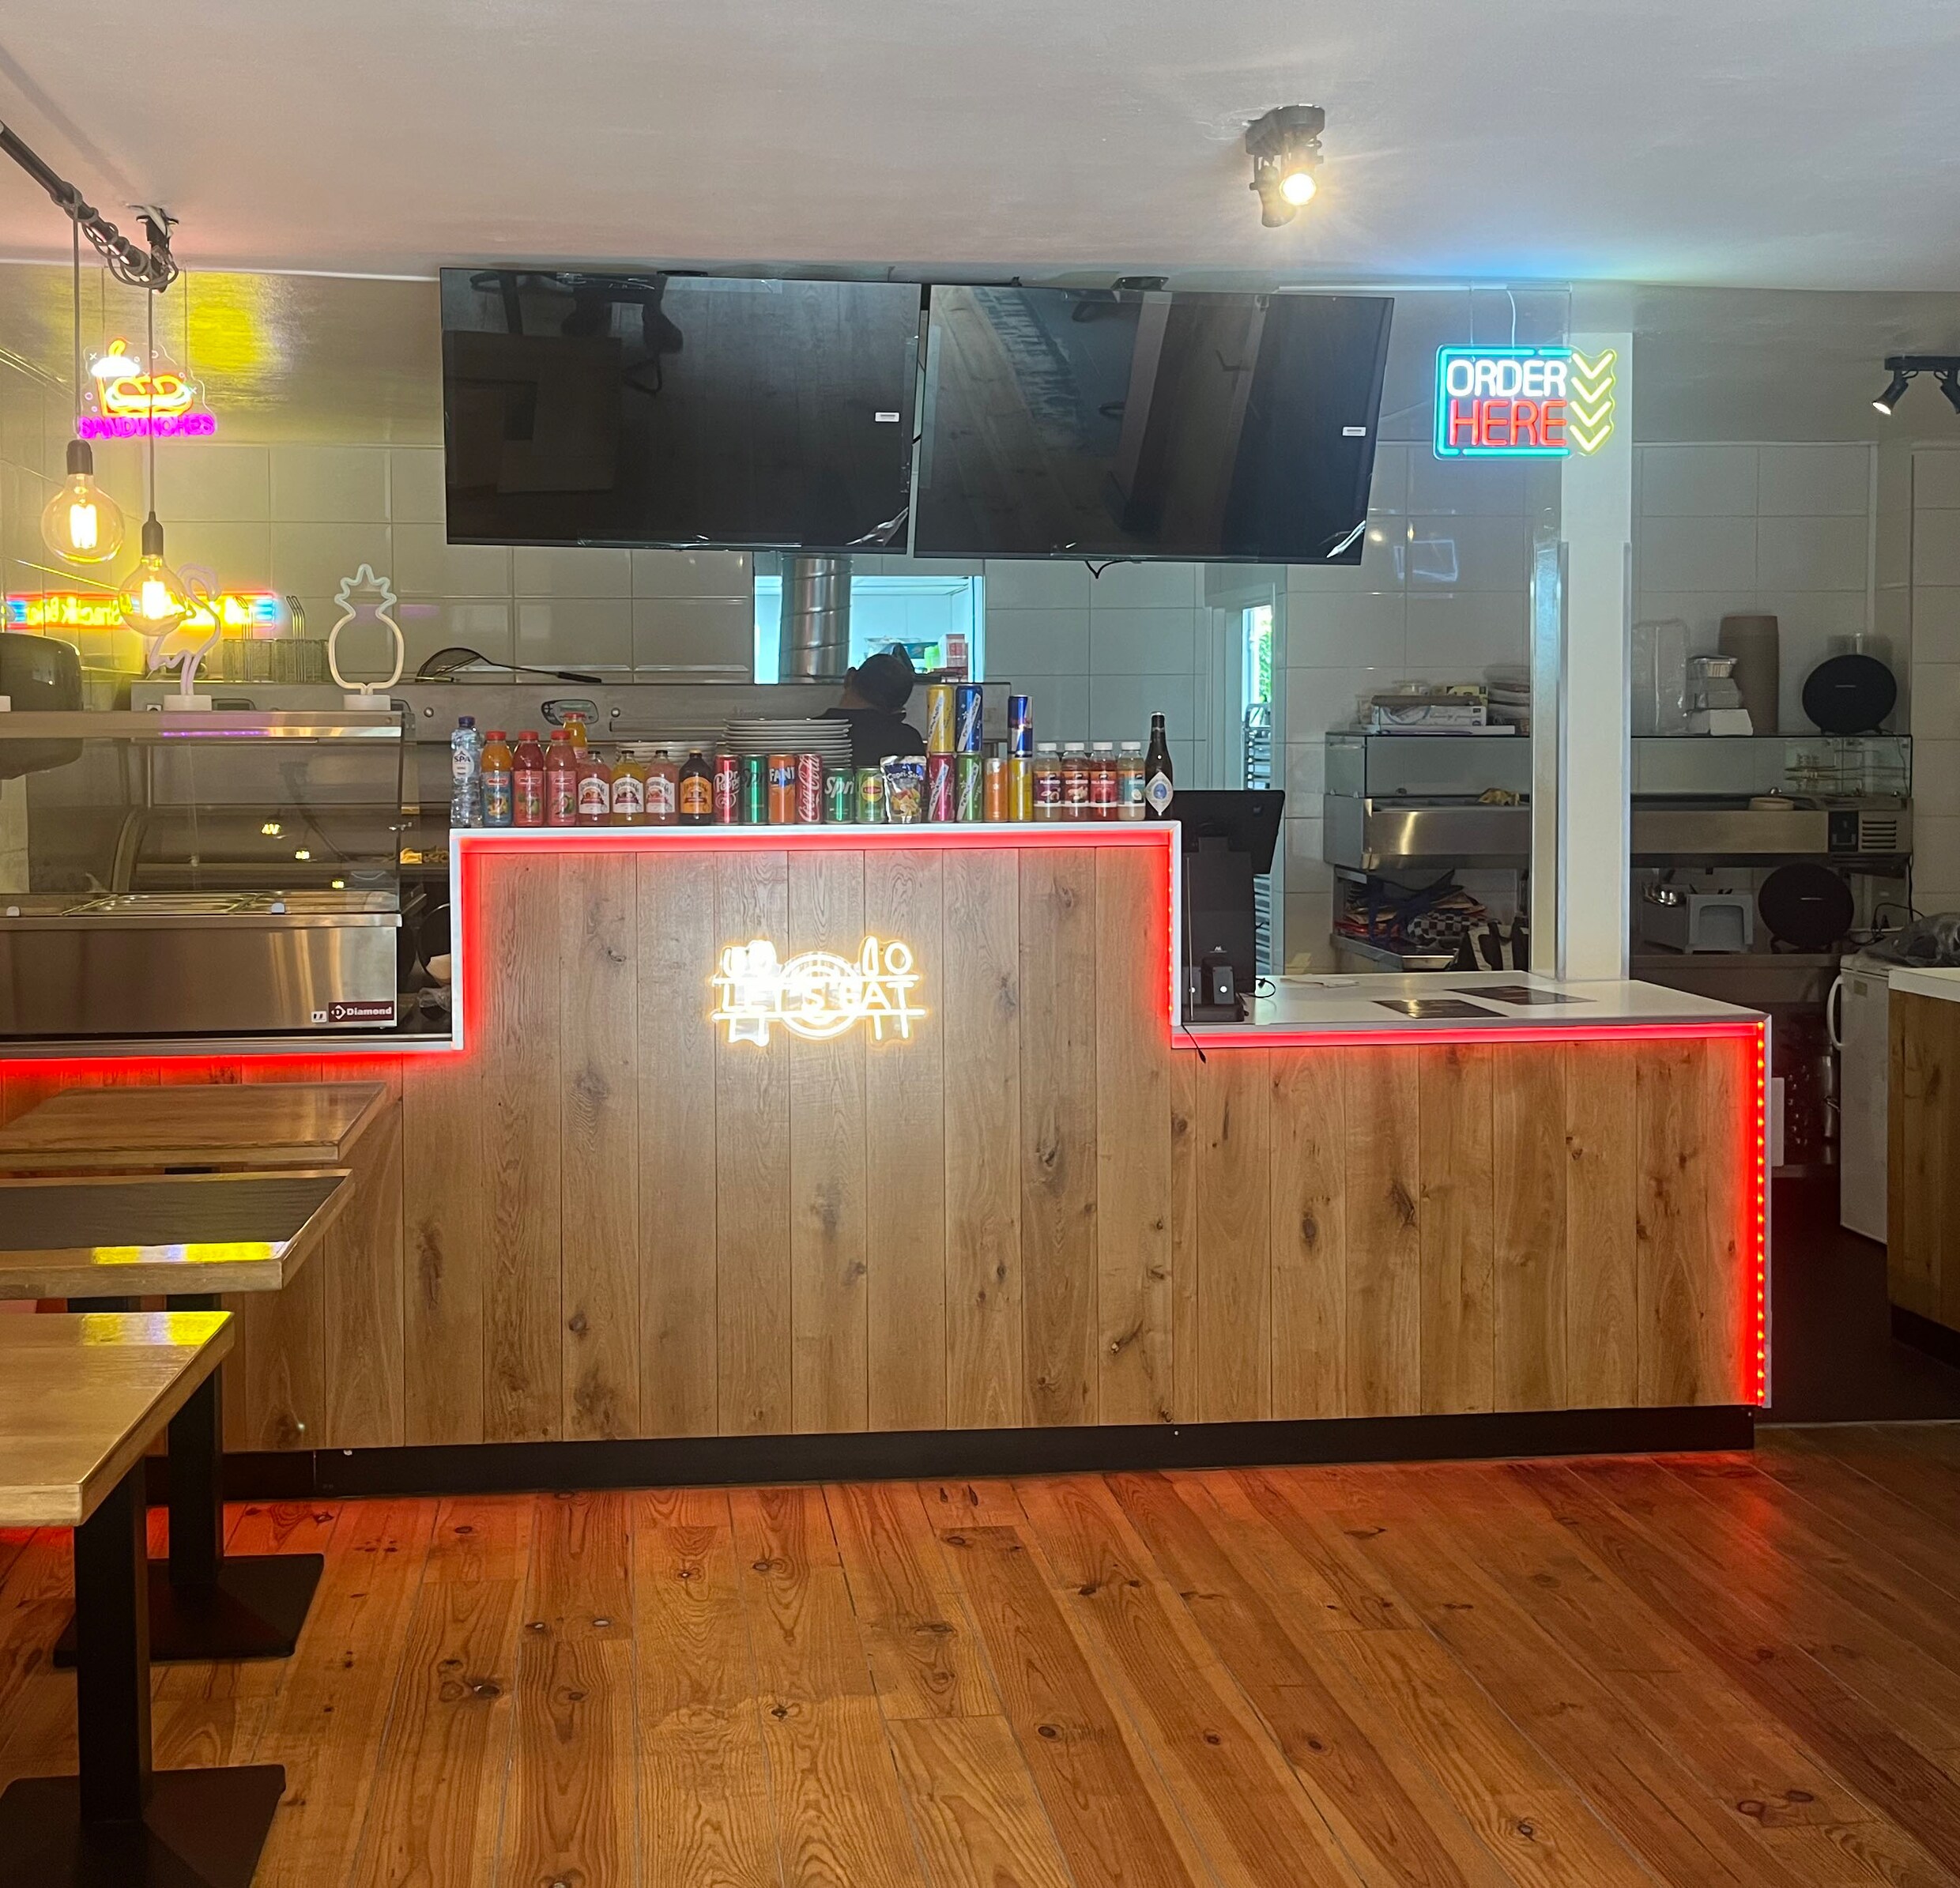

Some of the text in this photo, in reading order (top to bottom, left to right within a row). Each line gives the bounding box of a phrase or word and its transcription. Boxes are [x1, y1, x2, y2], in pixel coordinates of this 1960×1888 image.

[1446, 359, 1568, 397] ORDER
[1448, 398, 1568, 447] HERE
[768, 767, 795, 782] FANT
[824, 775, 855, 798] Spri
[346, 1007, 392, 1016] Diamond
